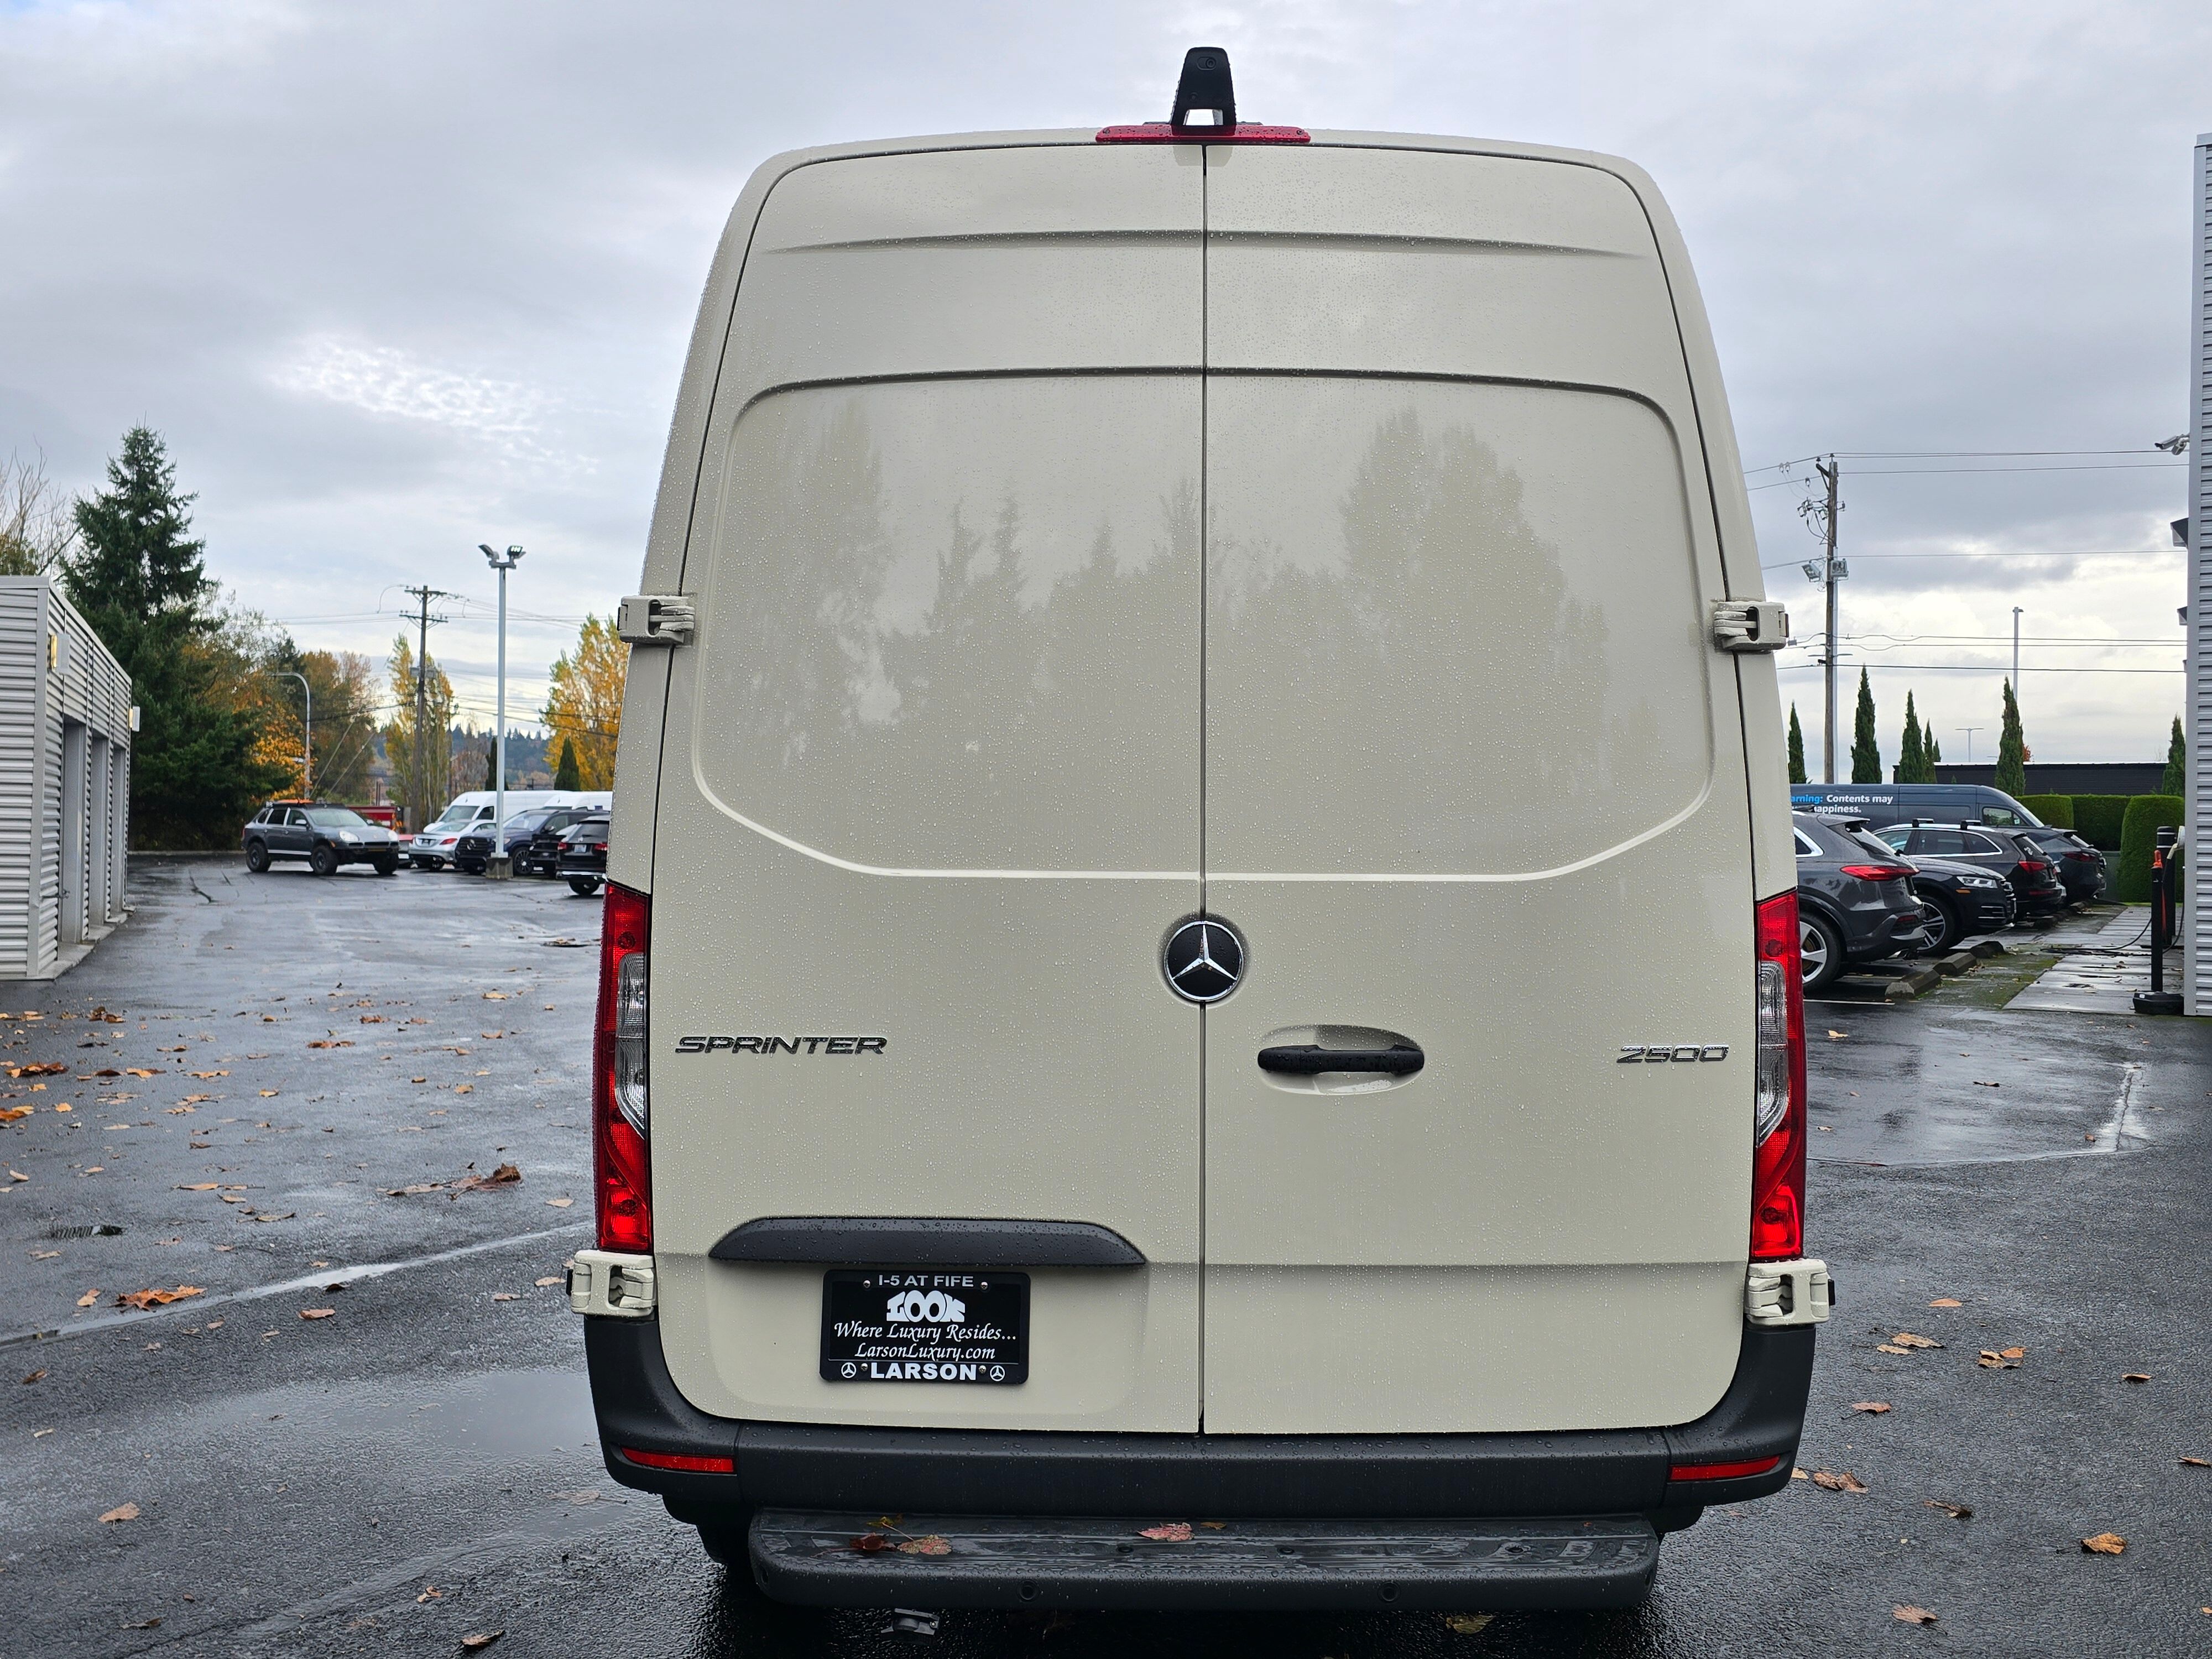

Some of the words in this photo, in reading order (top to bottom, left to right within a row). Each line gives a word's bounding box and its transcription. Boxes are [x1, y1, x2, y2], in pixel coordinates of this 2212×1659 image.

[1790, 794, 1823, 804] arning:
[1826, 795, 1870, 803] Contents
[1872, 795, 1893, 805] may
[675, 1036, 887, 1055] SPRINTER
[1616, 1044, 1729, 1063] 2500
[879, 1275, 900, 1286] I-5
[904, 1275, 928, 1286] AT
[934, 1276, 974, 1287] FIFE
[886, 1290, 966, 1323] LOOK
[833, 1320, 883, 1338] Where
[886, 1323, 942, 1345] Luxury
[945, 1323, 1016, 1342] Resides...
[854, 1342, 995, 1362] LarsonLuxury.com
[870, 1362, 977, 1381] LARSON
